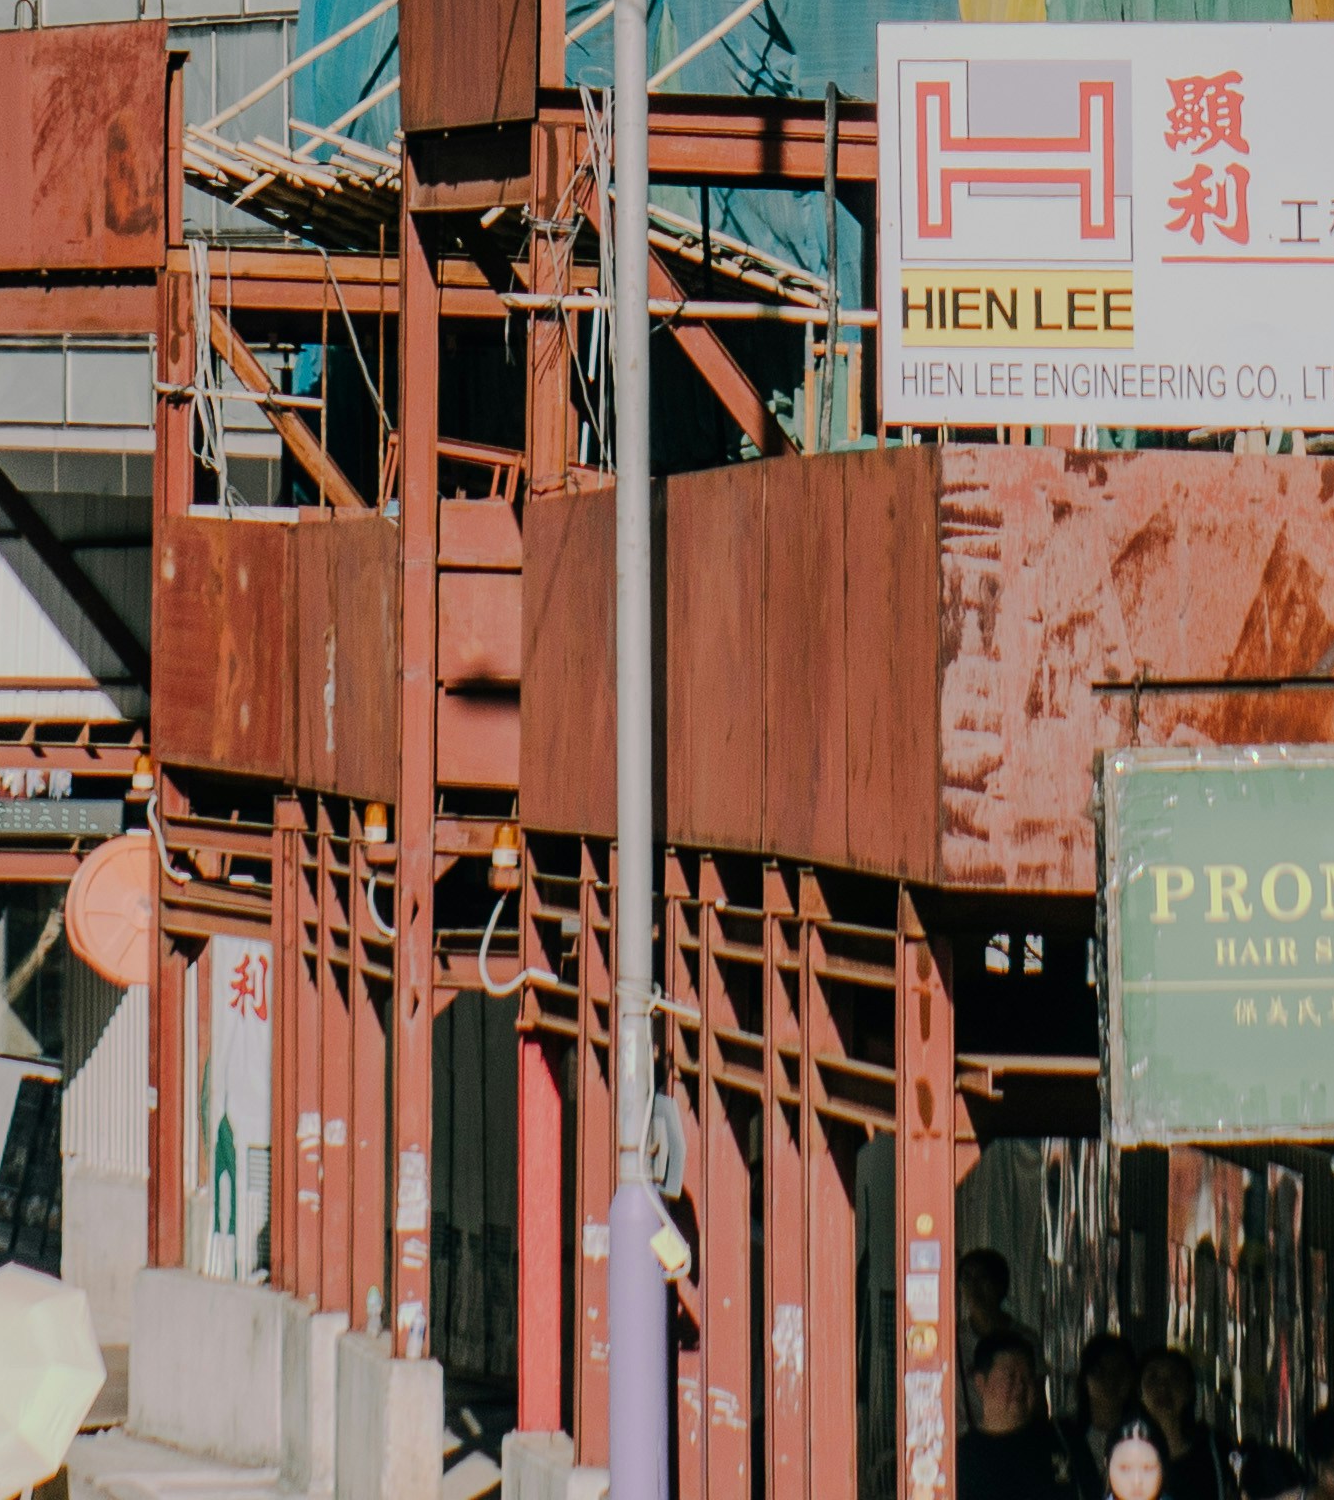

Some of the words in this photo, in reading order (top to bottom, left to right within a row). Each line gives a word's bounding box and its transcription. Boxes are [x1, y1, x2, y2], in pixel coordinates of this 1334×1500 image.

[1164, 69, 1252, 246] 顯利
[902, 286, 1018, 331] HIEN
[1034, 286, 1134, 331] LEE
[901, 361, 964, 398] HIEN
[973, 361, 1024, 398] LEE
[1034, 362, 1227, 400] ENGINEERING
[1236, 364, 1292, 406] CO.,
[1215, 934, 1299, 967] HAIR
[229, 954, 269, 1022] 利
